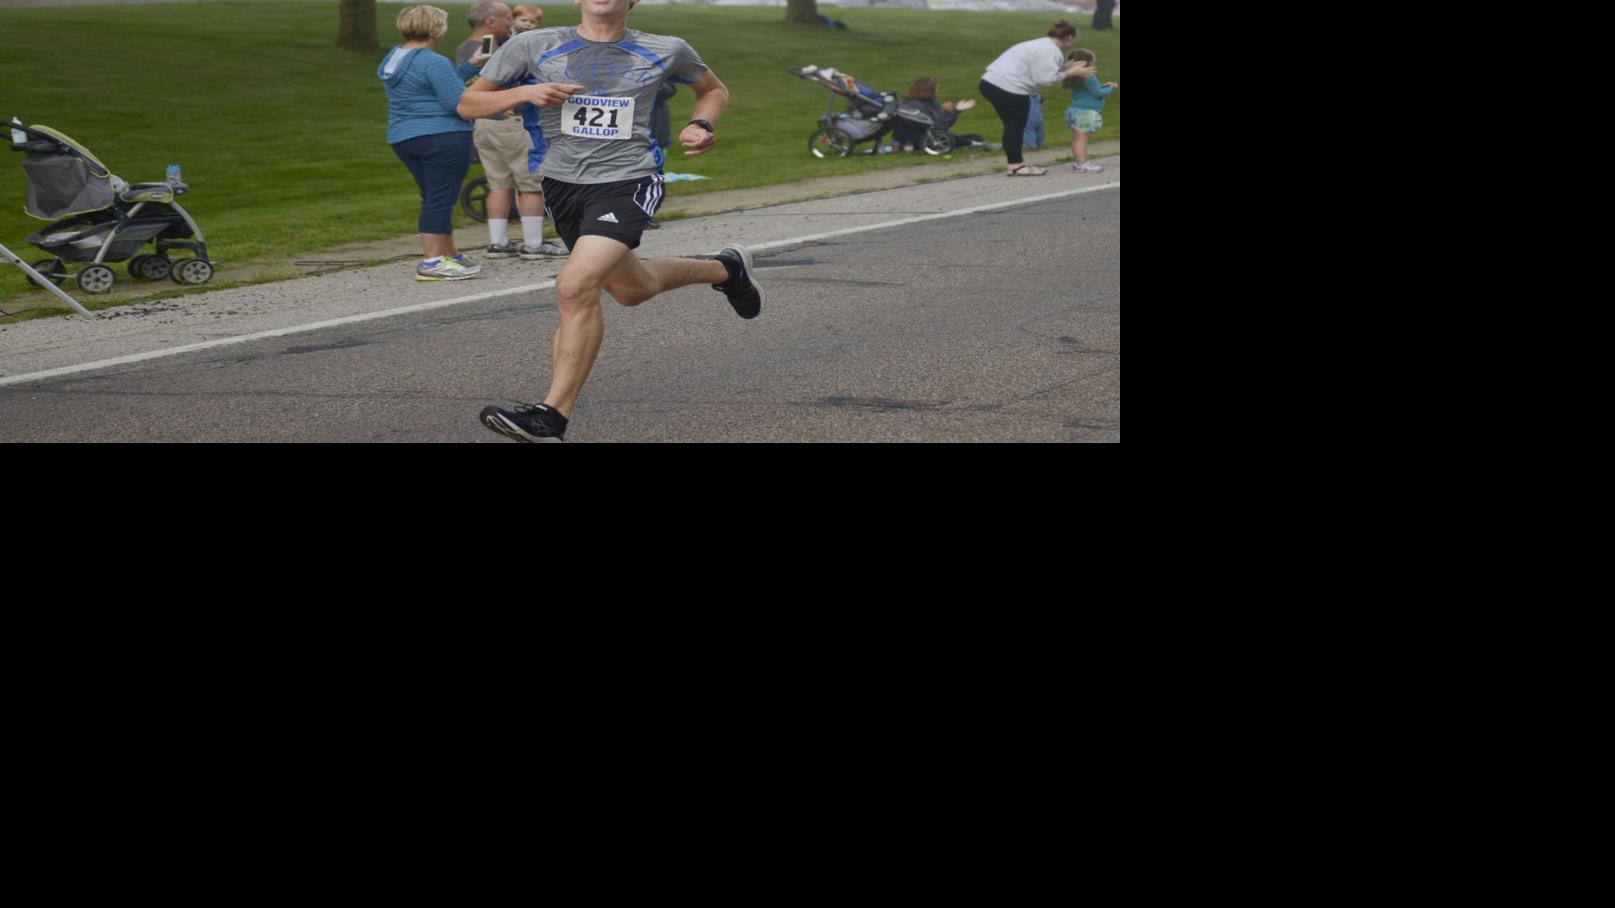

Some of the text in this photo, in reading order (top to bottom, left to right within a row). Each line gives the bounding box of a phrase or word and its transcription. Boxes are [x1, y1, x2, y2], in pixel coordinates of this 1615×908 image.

[567, 96, 630, 107] GOODVIEW
[573, 107, 618, 128] 421
[572, 126, 619, 137] GALLOP
